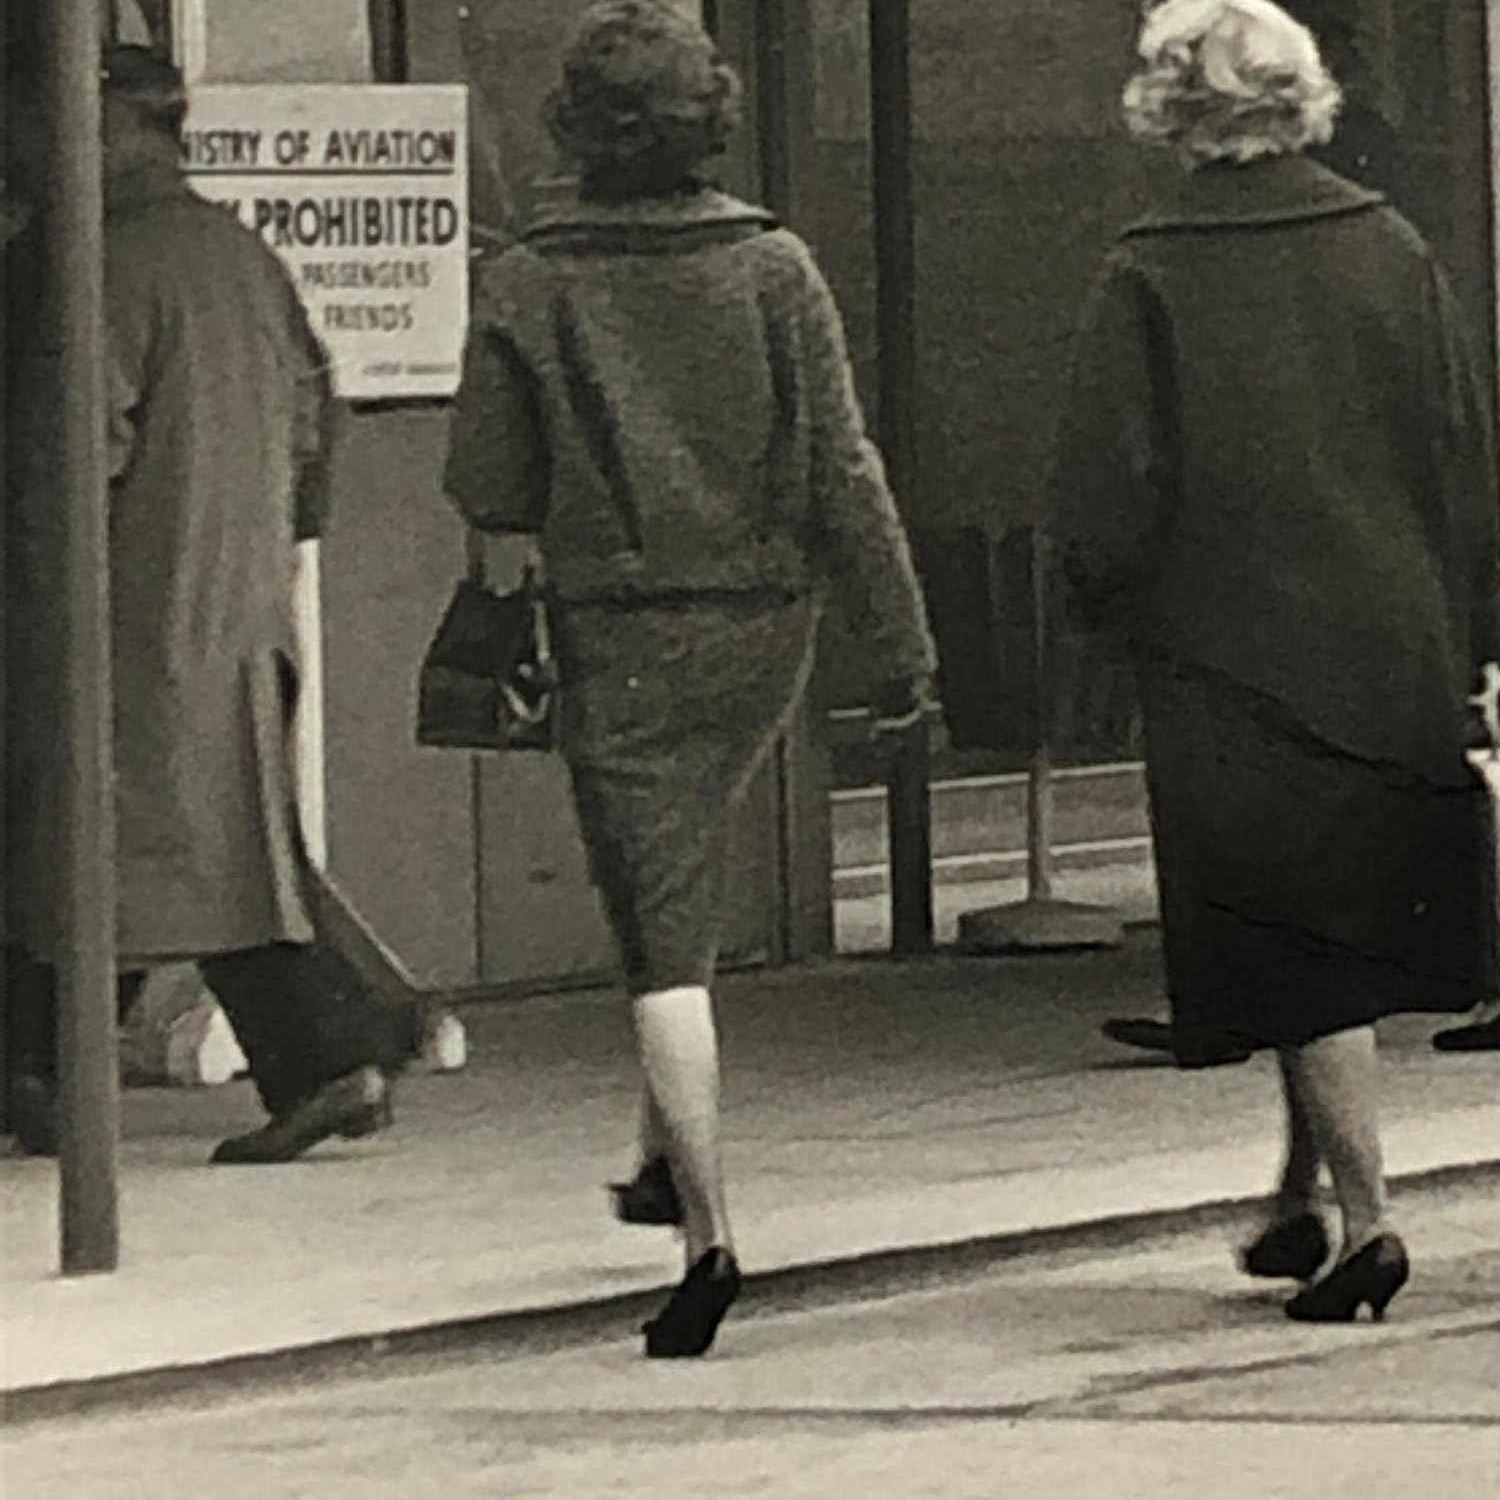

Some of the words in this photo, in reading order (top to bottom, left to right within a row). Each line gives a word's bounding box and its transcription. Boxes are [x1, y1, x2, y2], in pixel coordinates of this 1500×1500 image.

[274, 130, 310, 165] OF
[324, 129, 456, 165] AVIATION
[254, 197, 458, 248] PROHIBITED
[301, 260, 431, 290] PASSENGERS
[323, 303, 414, 332] FRIENDS
